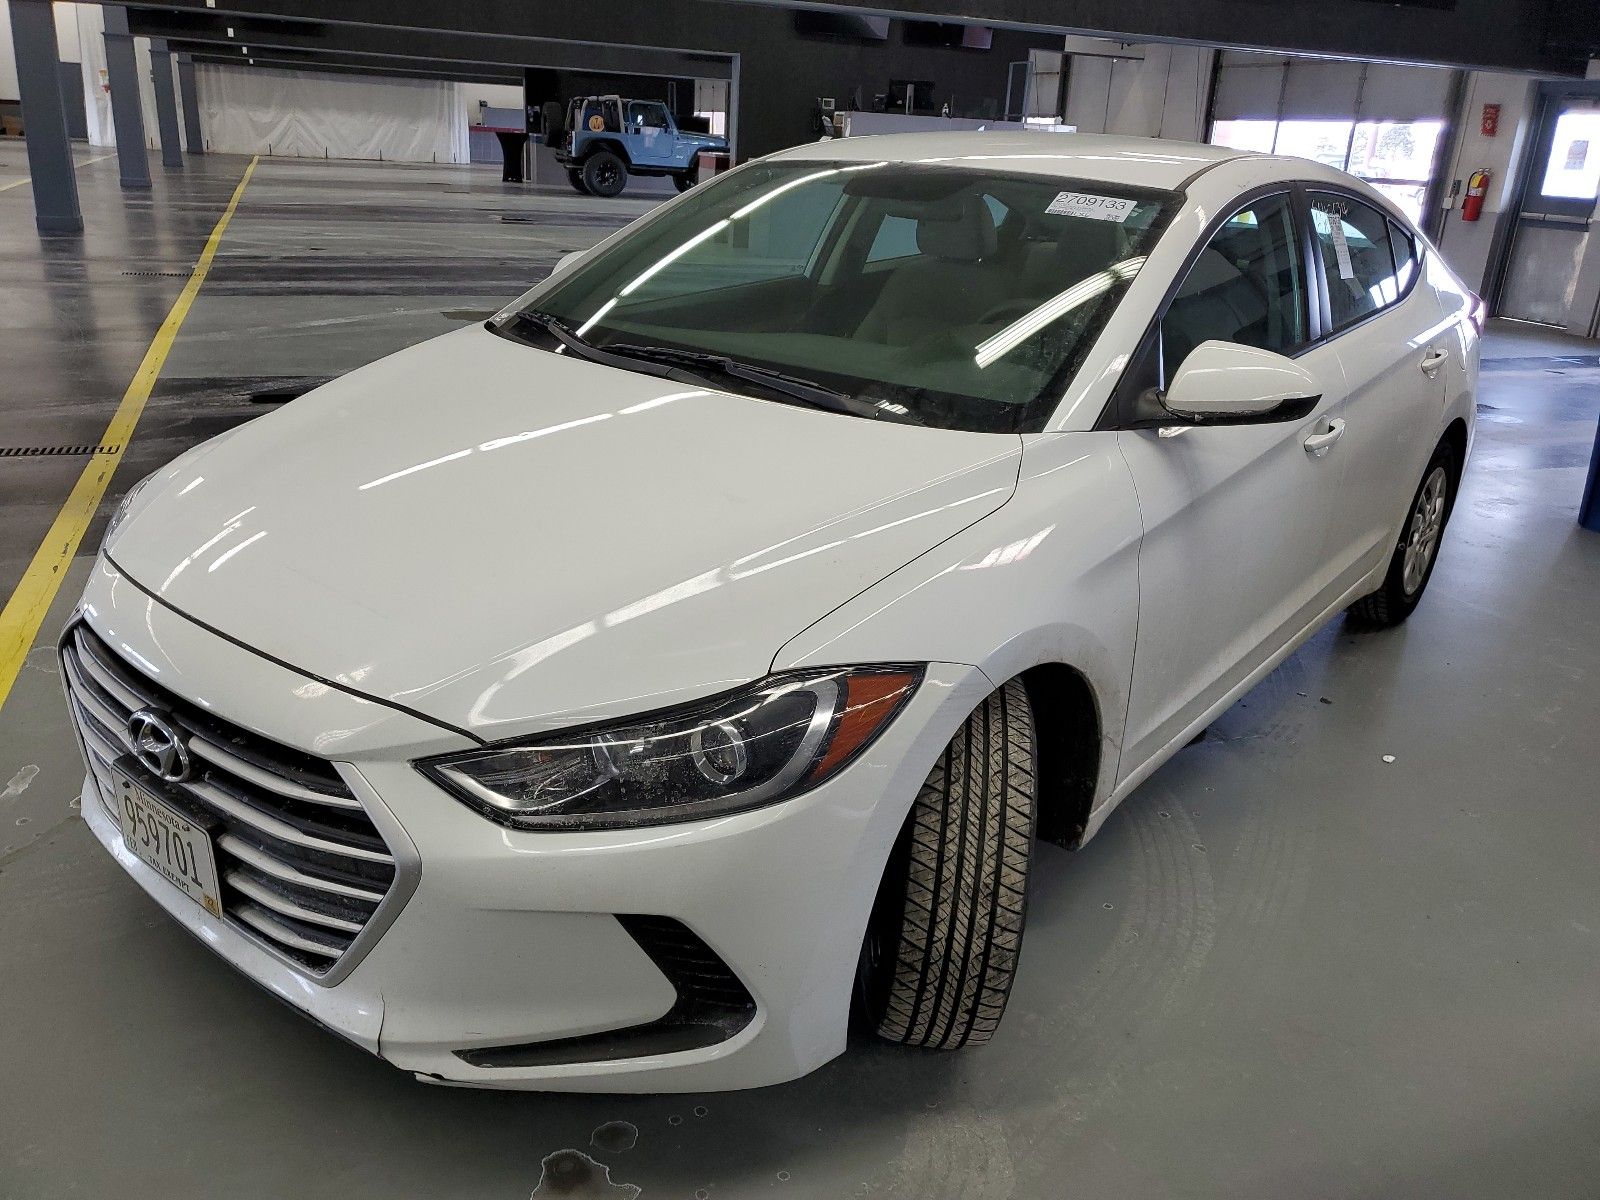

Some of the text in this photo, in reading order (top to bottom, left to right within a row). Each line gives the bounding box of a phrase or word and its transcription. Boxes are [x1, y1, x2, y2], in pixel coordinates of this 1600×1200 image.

[1056, 194, 1127, 210] 2709133
[133, 786, 181, 830] Minnesota
[123, 794, 203, 889] 959701
